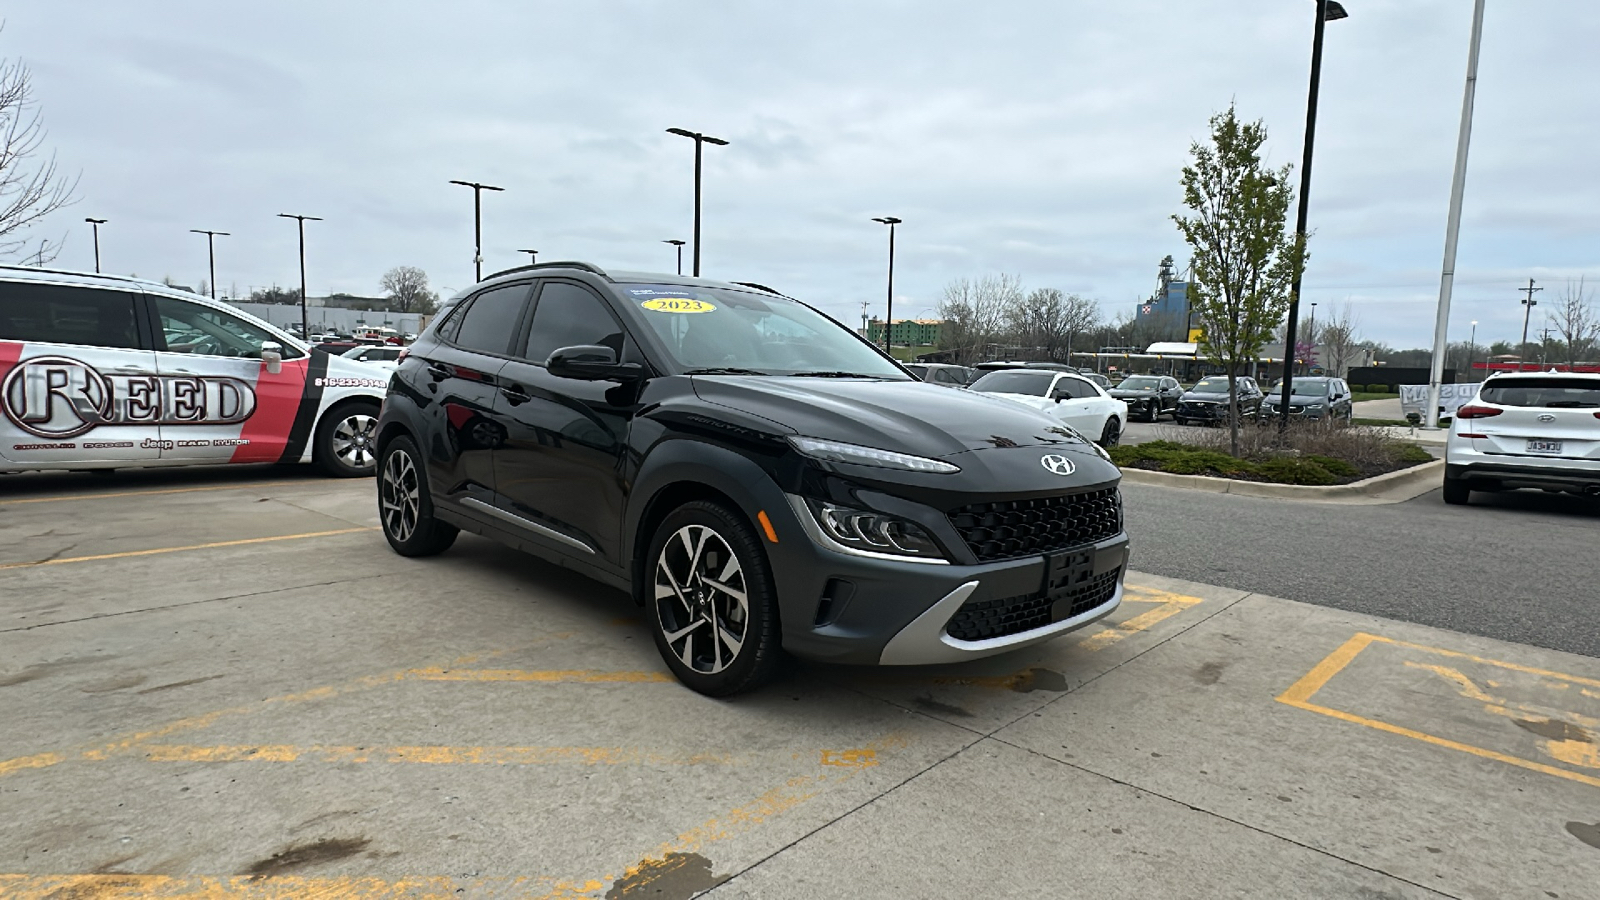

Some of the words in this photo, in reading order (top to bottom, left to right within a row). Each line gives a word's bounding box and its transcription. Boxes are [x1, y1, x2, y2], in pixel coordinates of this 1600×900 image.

[656, 301, 703, 310] 2023
[16, 362, 255, 427] REED
[141, 438, 173, 450] Jeep
[213, 439, 250, 447] HYUNDAI
